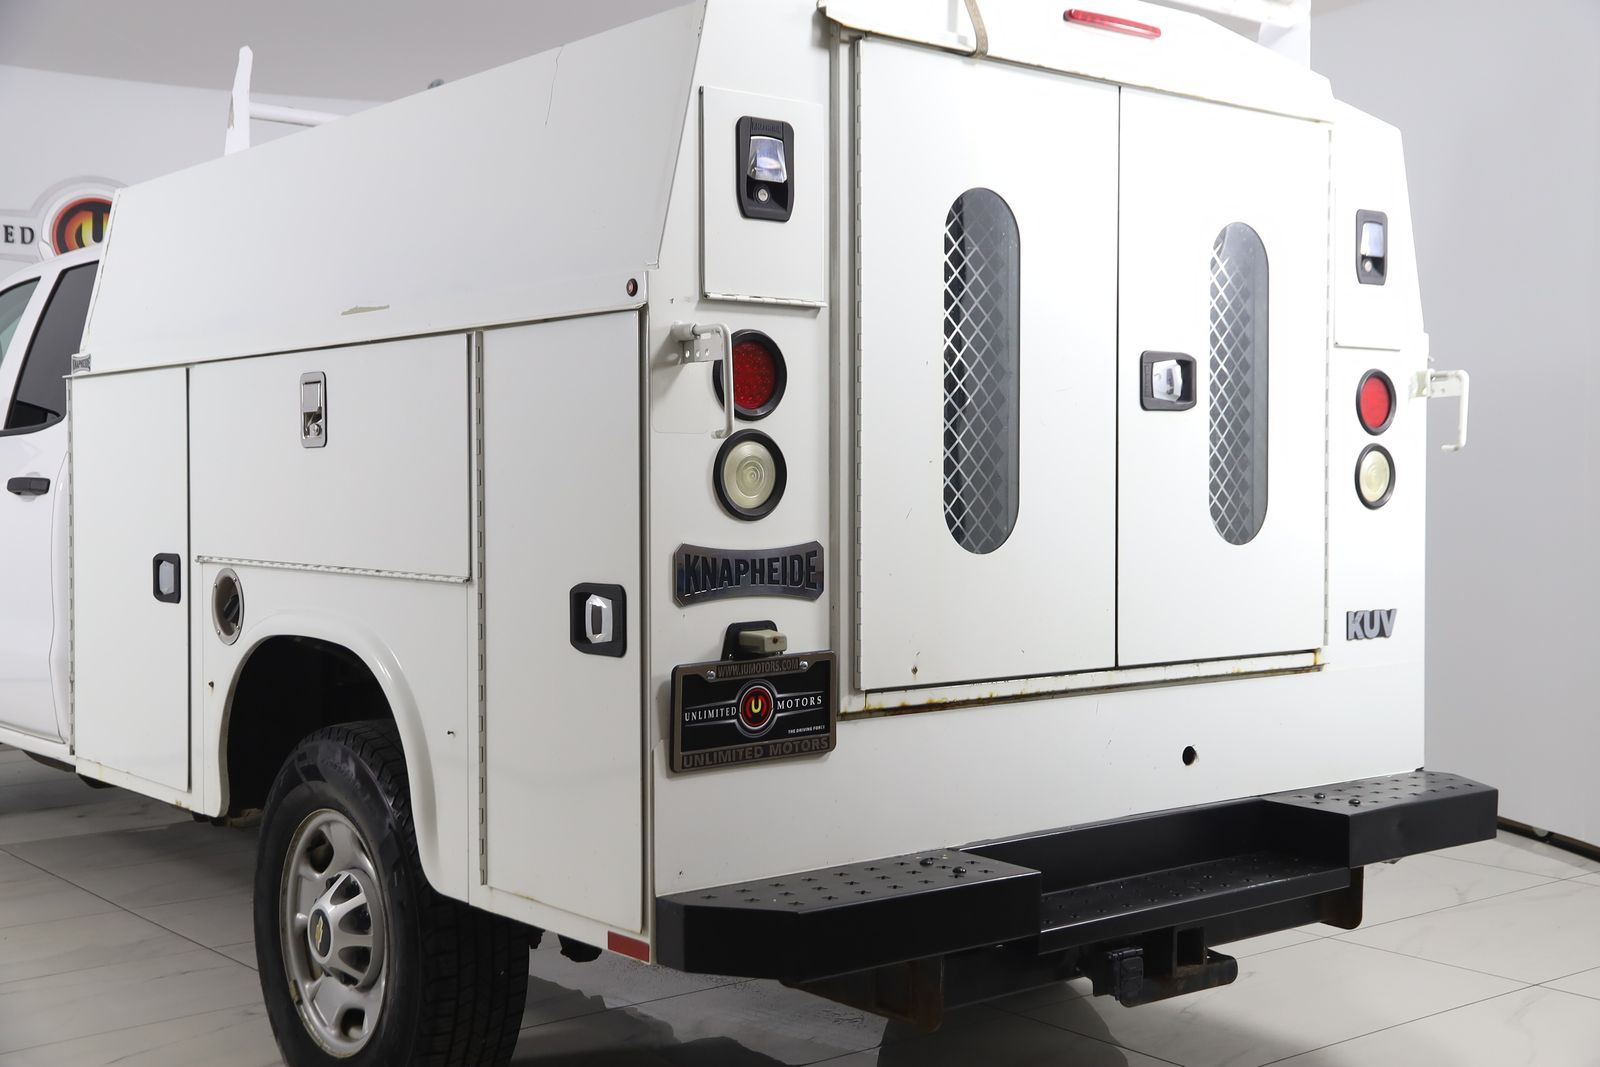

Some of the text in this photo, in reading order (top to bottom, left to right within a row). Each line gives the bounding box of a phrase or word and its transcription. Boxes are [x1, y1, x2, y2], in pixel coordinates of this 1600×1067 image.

[683, 550, 818, 597] KNAPHEIDE
[1346, 608, 1397, 641] KUV
[684, 696, 822, 722] UNLIMITED MOTORS
[682, 738, 829, 768] UNLIMITED MOTORS
